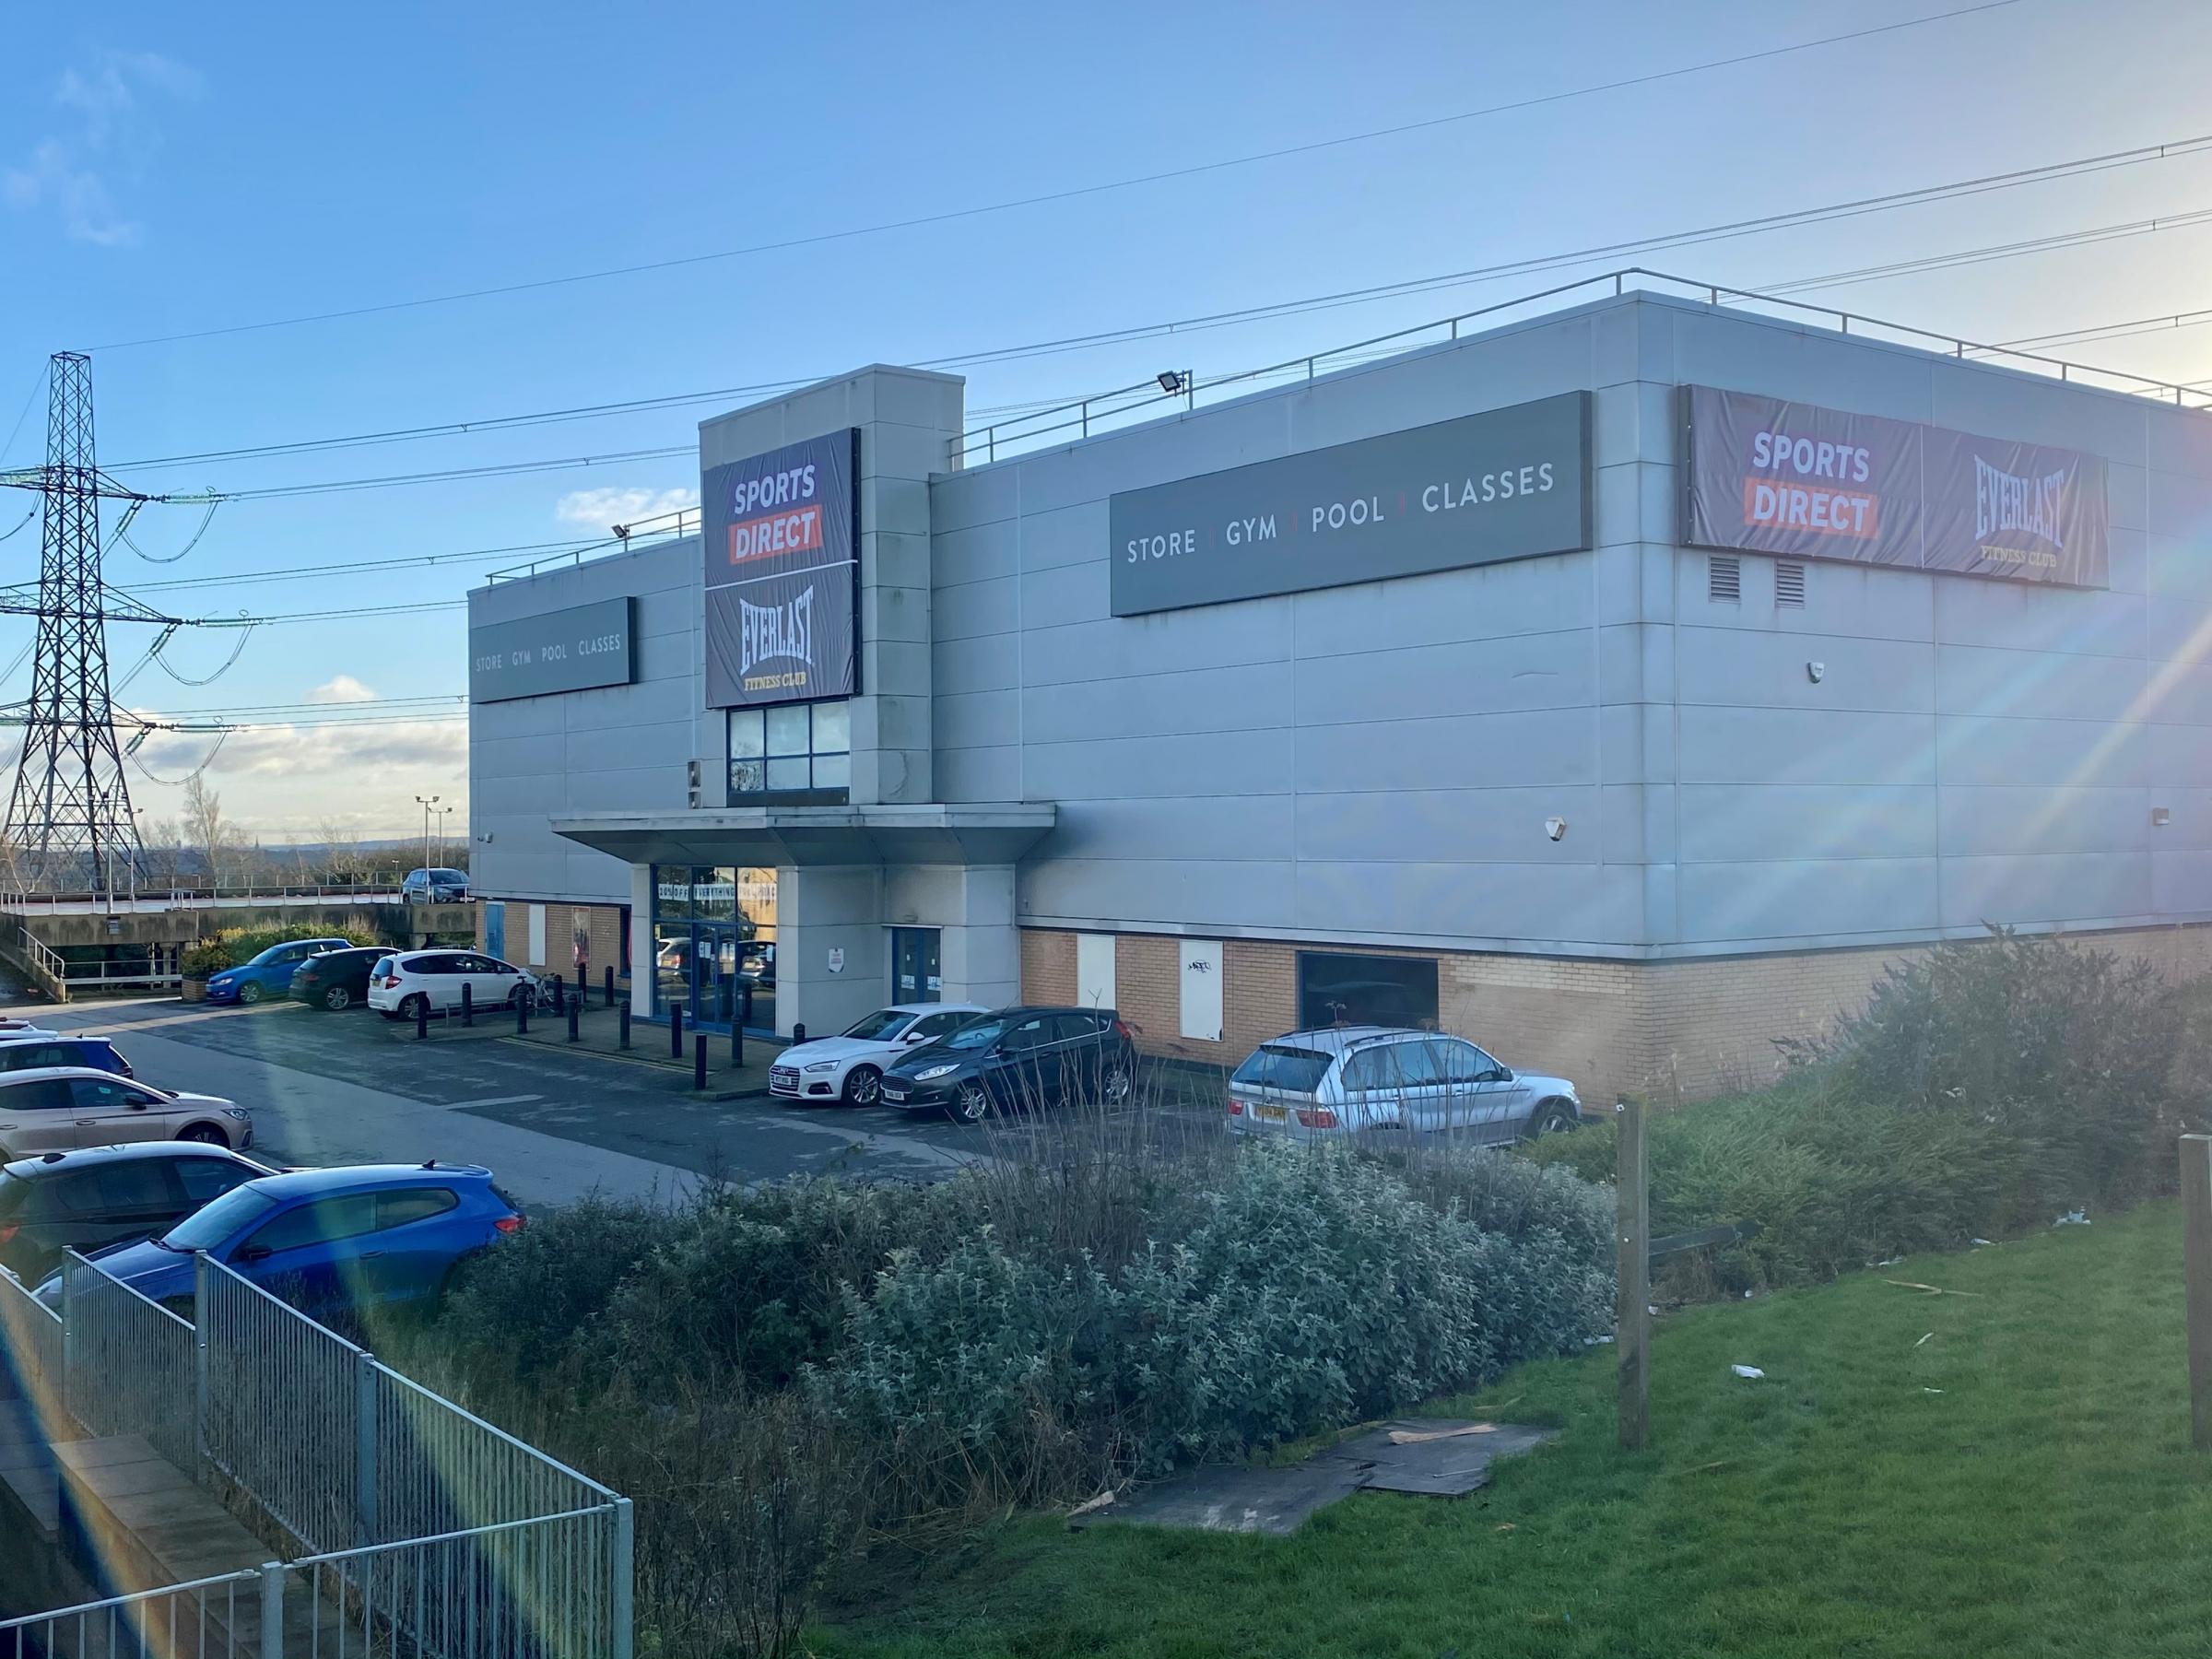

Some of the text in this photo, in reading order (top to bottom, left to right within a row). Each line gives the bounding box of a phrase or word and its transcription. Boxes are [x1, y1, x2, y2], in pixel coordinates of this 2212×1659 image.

[1753, 432, 1870, 482] SPORTS
[735, 465, 815, 514] SPORTS
[1127, 463, 1555, 563] STORE GYM POOL CLASSES
[1753, 485, 1870, 532] DIRECT
[1974, 454, 2065, 549] EVERLAST
[736, 512, 815, 559] DIRECT
[1980, 545, 2057, 568] FITNESS CLUB
[477, 634, 620, 672] STORE GYM POOL CLASSES
[740, 584, 814, 676] EVERLAST
[744, 672, 806, 691] FITNESS CLUB
